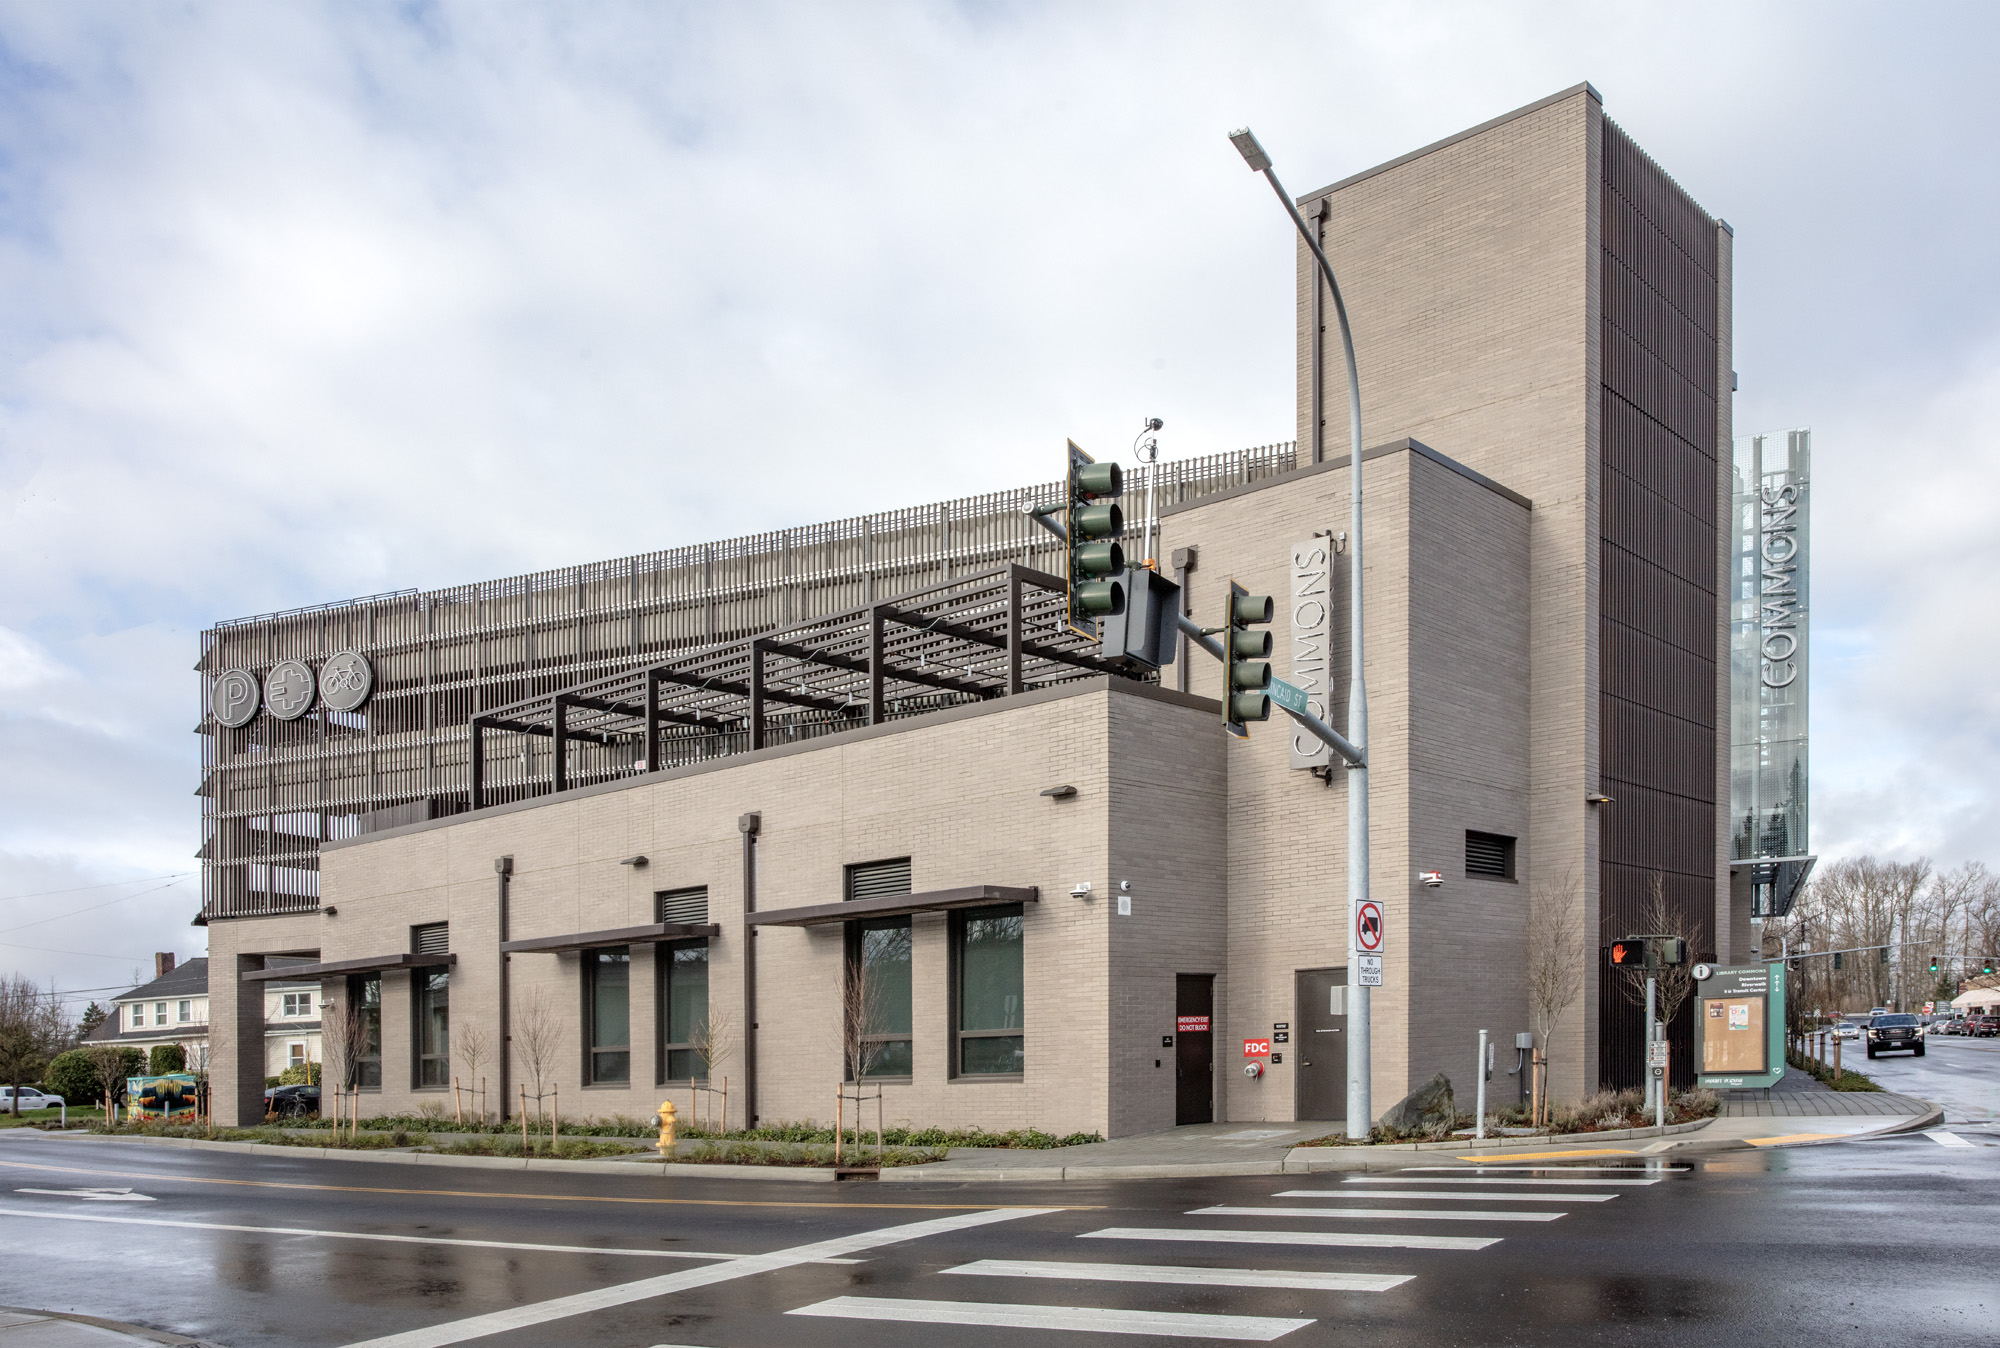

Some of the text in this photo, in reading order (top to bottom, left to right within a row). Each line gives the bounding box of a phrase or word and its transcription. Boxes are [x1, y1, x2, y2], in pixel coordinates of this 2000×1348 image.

[1762, 484, 1798, 688] COMMONS
[223, 677, 248, 720] P
[1269, 681, 1291, 703] INCAID
[1361, 967, 1381, 975] THROUGH
[1245, 1042, 1268, 1053] FDC
